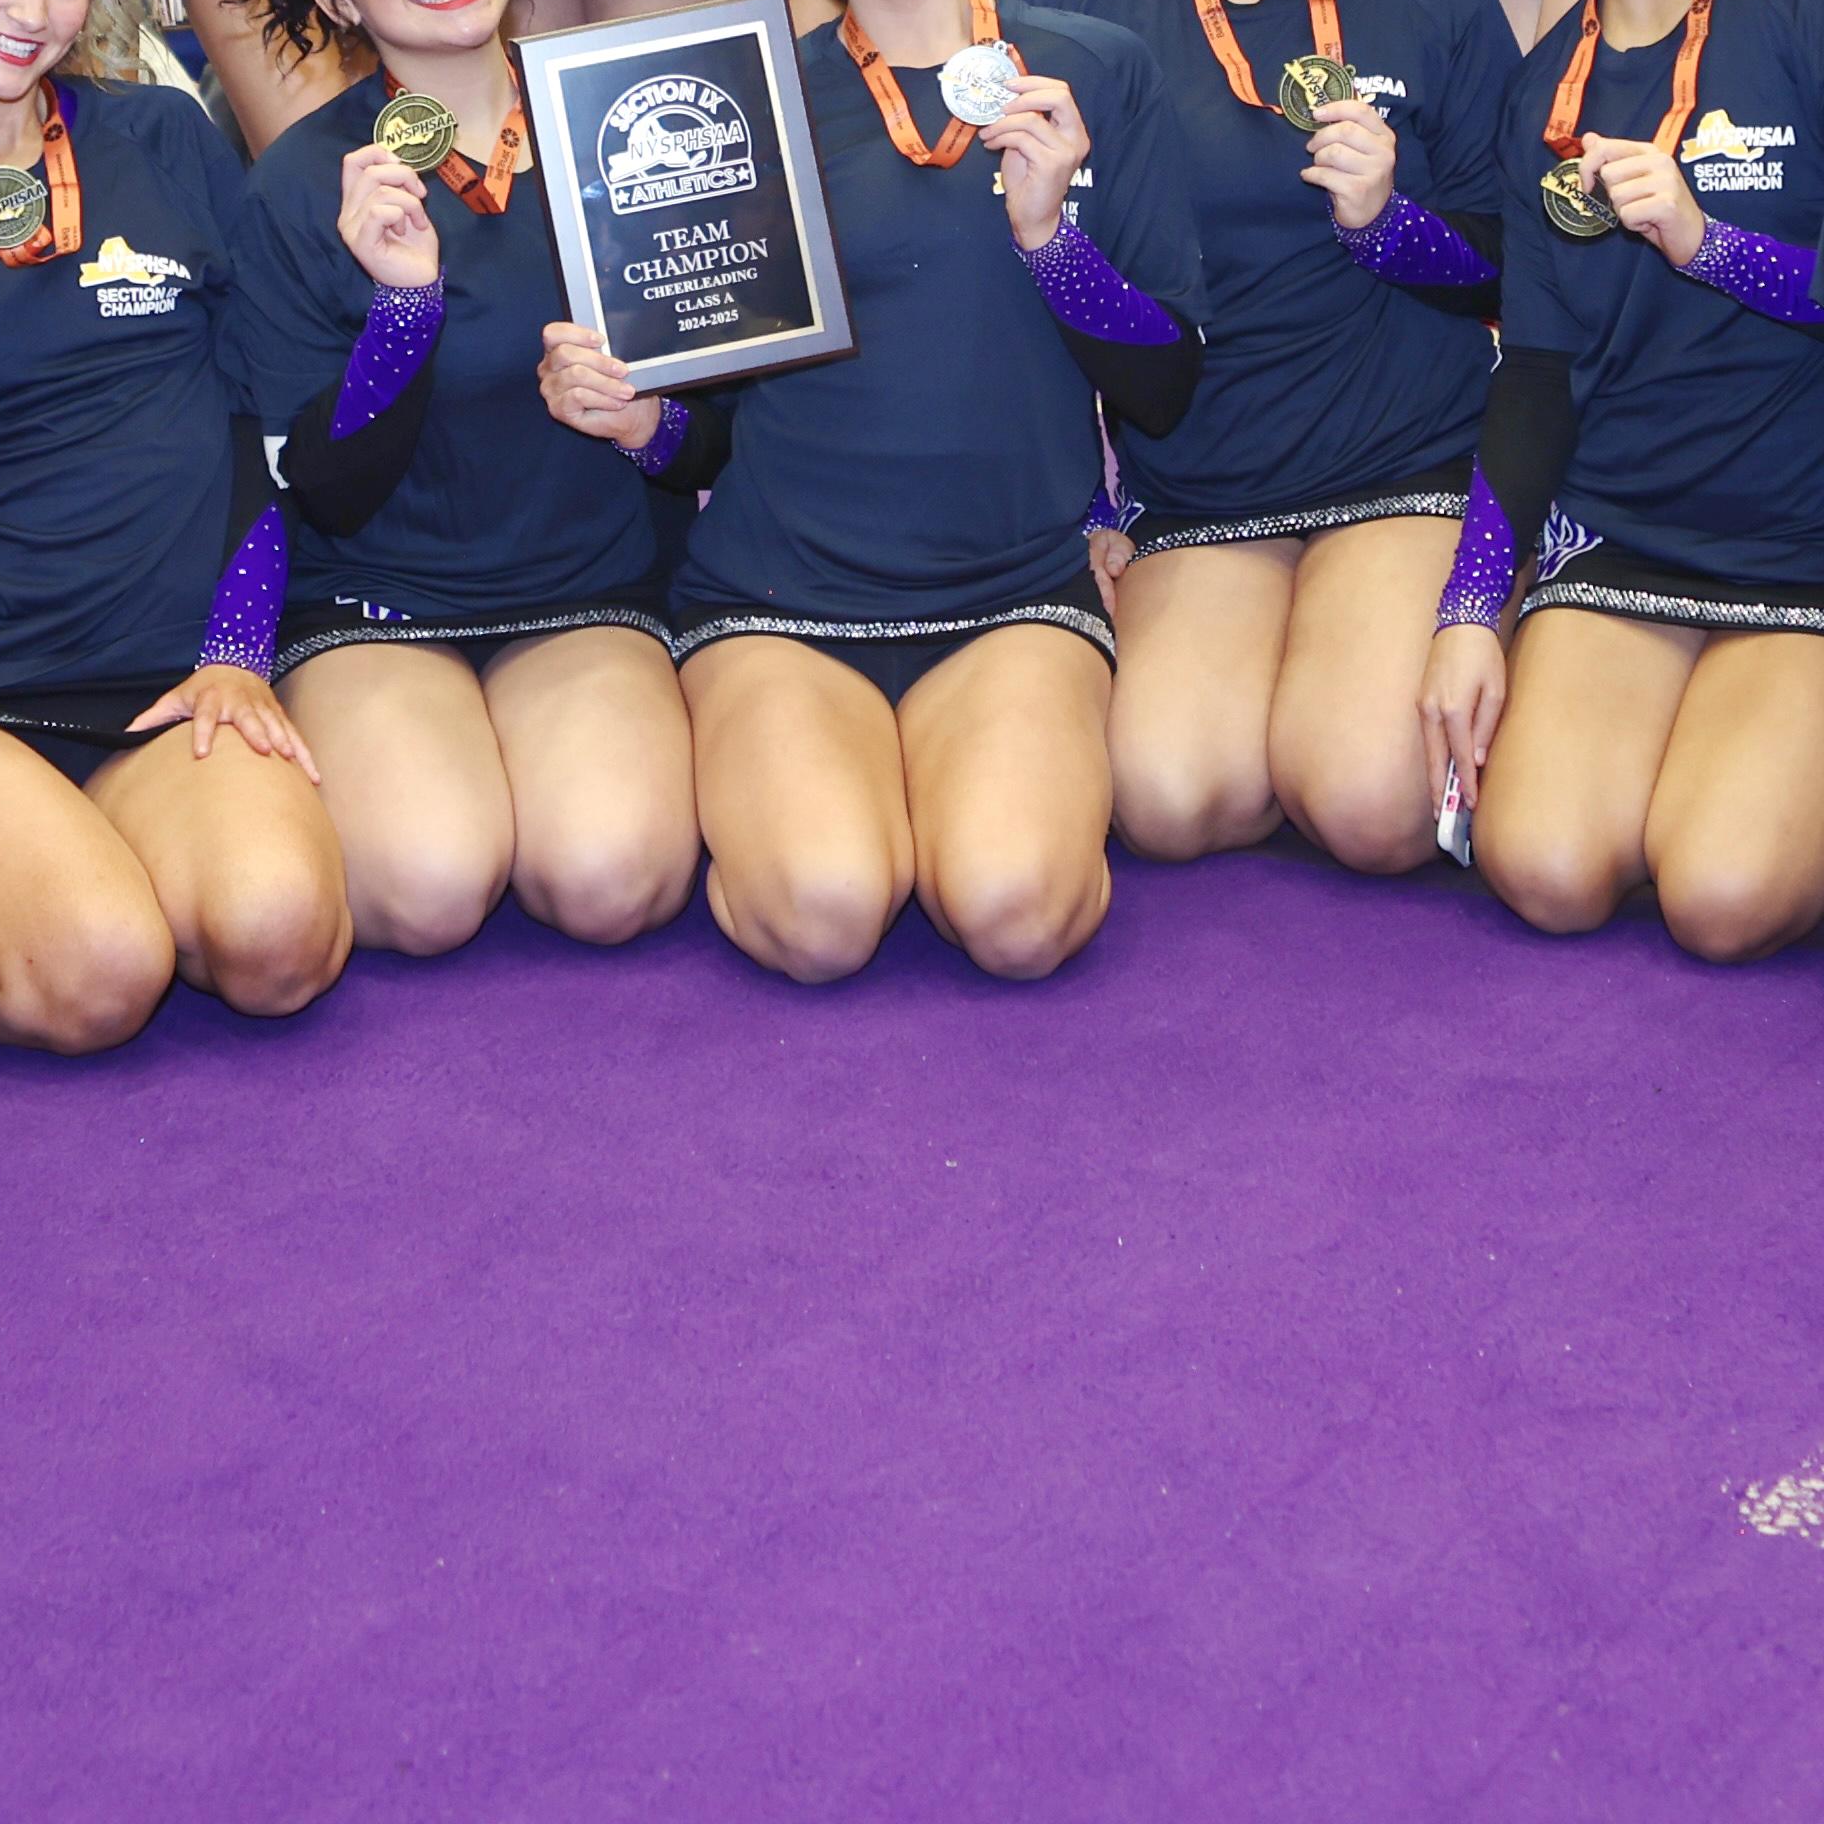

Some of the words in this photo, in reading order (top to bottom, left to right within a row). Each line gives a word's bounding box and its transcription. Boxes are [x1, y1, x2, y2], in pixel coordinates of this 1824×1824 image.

[1352, 75, 1407, 98] PHSAA
[609, 80, 697, 133] SECTION
[698, 86, 726, 115] IX
[386, 113, 455, 145] NYSPHSAA
[629, 119, 746, 161] NYSPHSAA
[1696, 126, 1796, 147] NYSPHSAA
[1694, 162, 1765, 178] SECTION
[1767, 161, 1784, 176] IX
[1697, 175, 1783, 192] CHAMPION
[631, 167, 738, 205] ATHLETICS
[1557, 178, 1617, 226] NYSPHSAA
[653, 219, 732, 253] TEAM
[98, 253, 192, 281] NYSPHSAA
[622, 238, 770, 286] CHAMPION
[96, 287, 164, 303] SECTION
[642, 267, 759, 301] CHEERLEADING
[100, 297, 175, 318] CHAMPION
[675, 294, 720, 314] CLASS
[720, 291, 735, 306] A
[677, 309, 740, 333] 2024-2025
